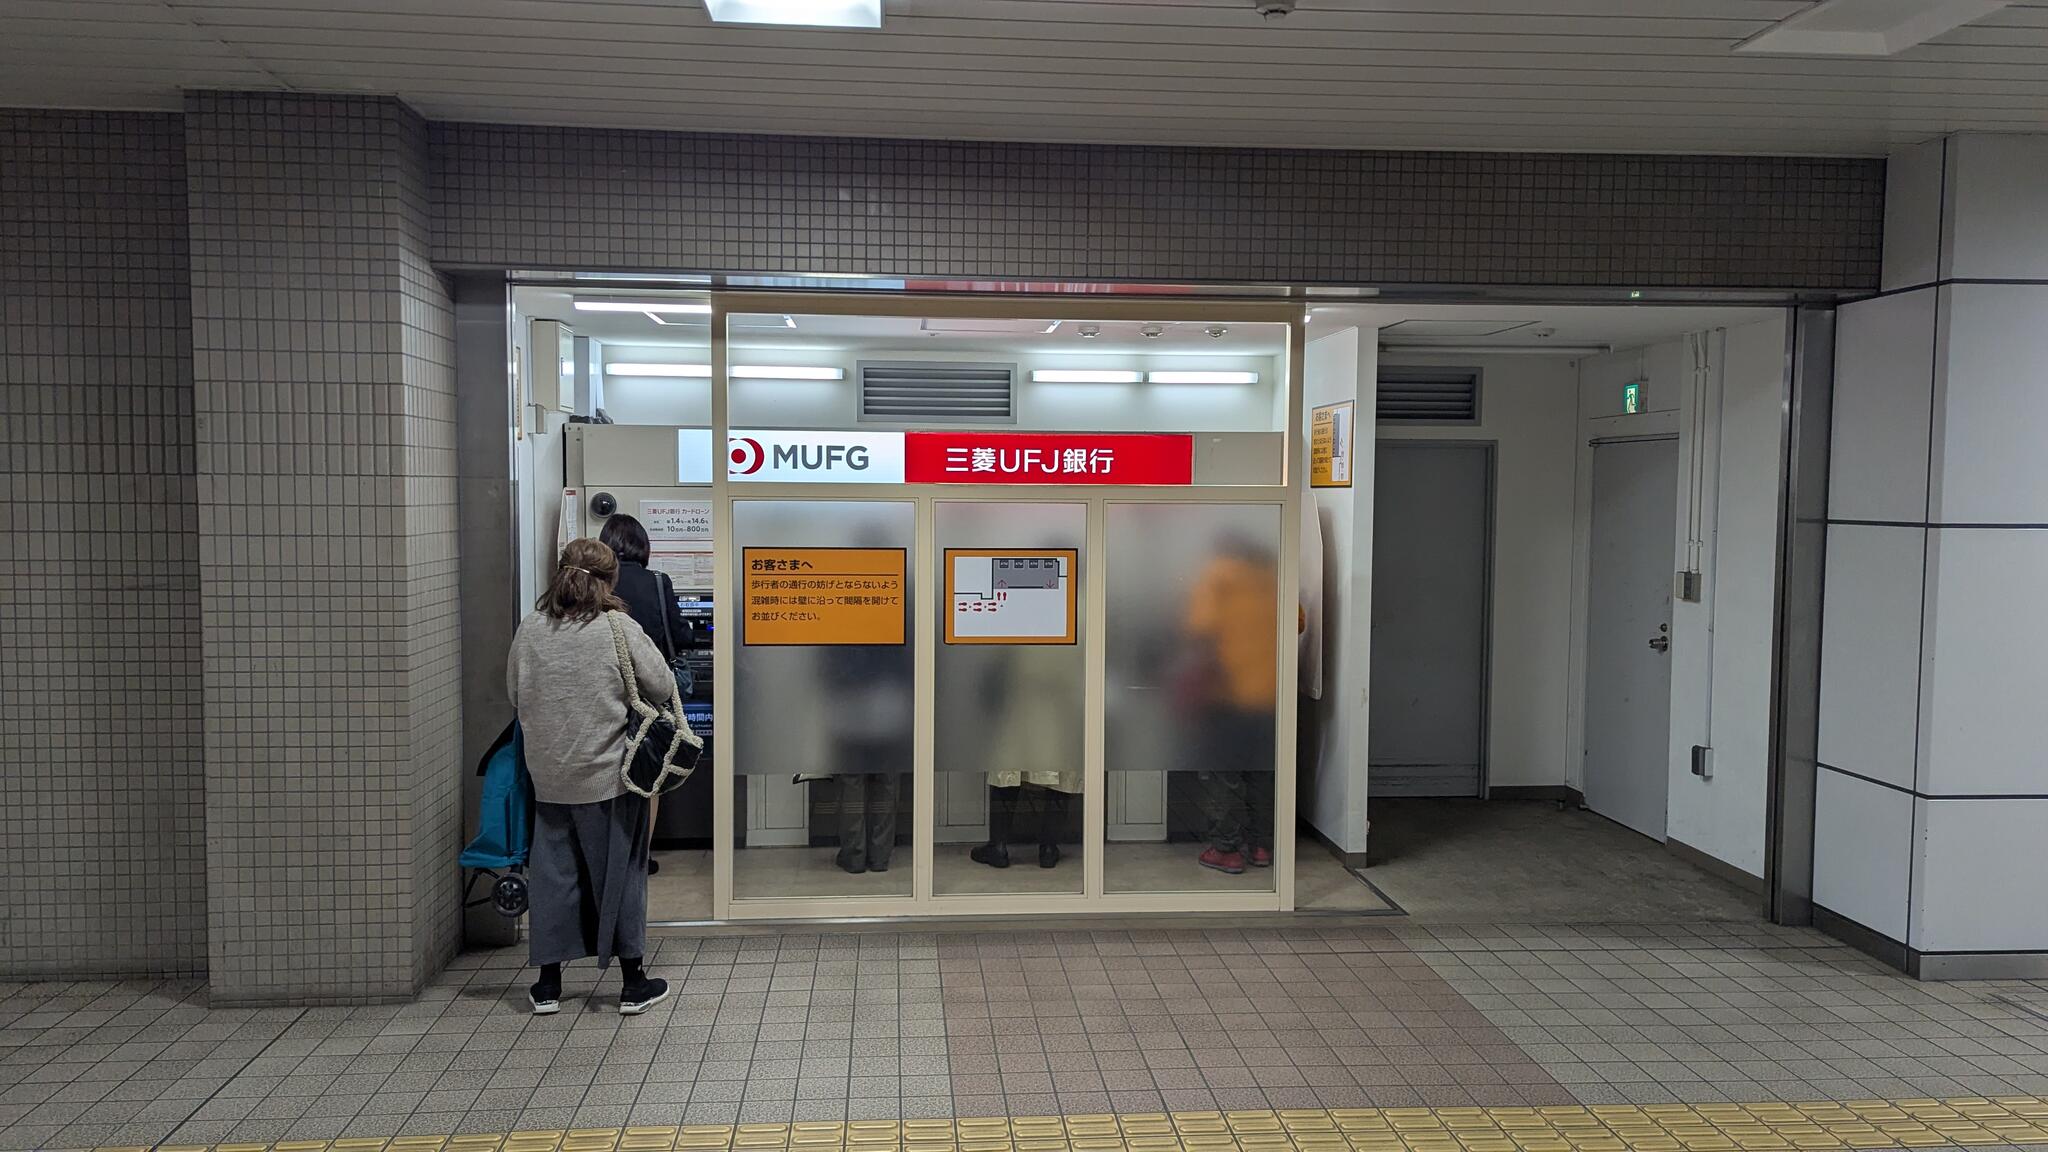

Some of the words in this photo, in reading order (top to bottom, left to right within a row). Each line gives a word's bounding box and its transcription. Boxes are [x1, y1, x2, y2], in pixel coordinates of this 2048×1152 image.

[773, 444, 869, 470] MUFG
[946, 447, 1114, 473] 三菱UFJ銀行
[751, 559, 813, 571] お客さまへ
[751, 580, 898, 590] 歩行者の通行の妨げとならないよう
[751, 595, 899, 606] 混雑時には壁に沿って間隔を開けて
[751, 611, 821, 621] お並びください。
